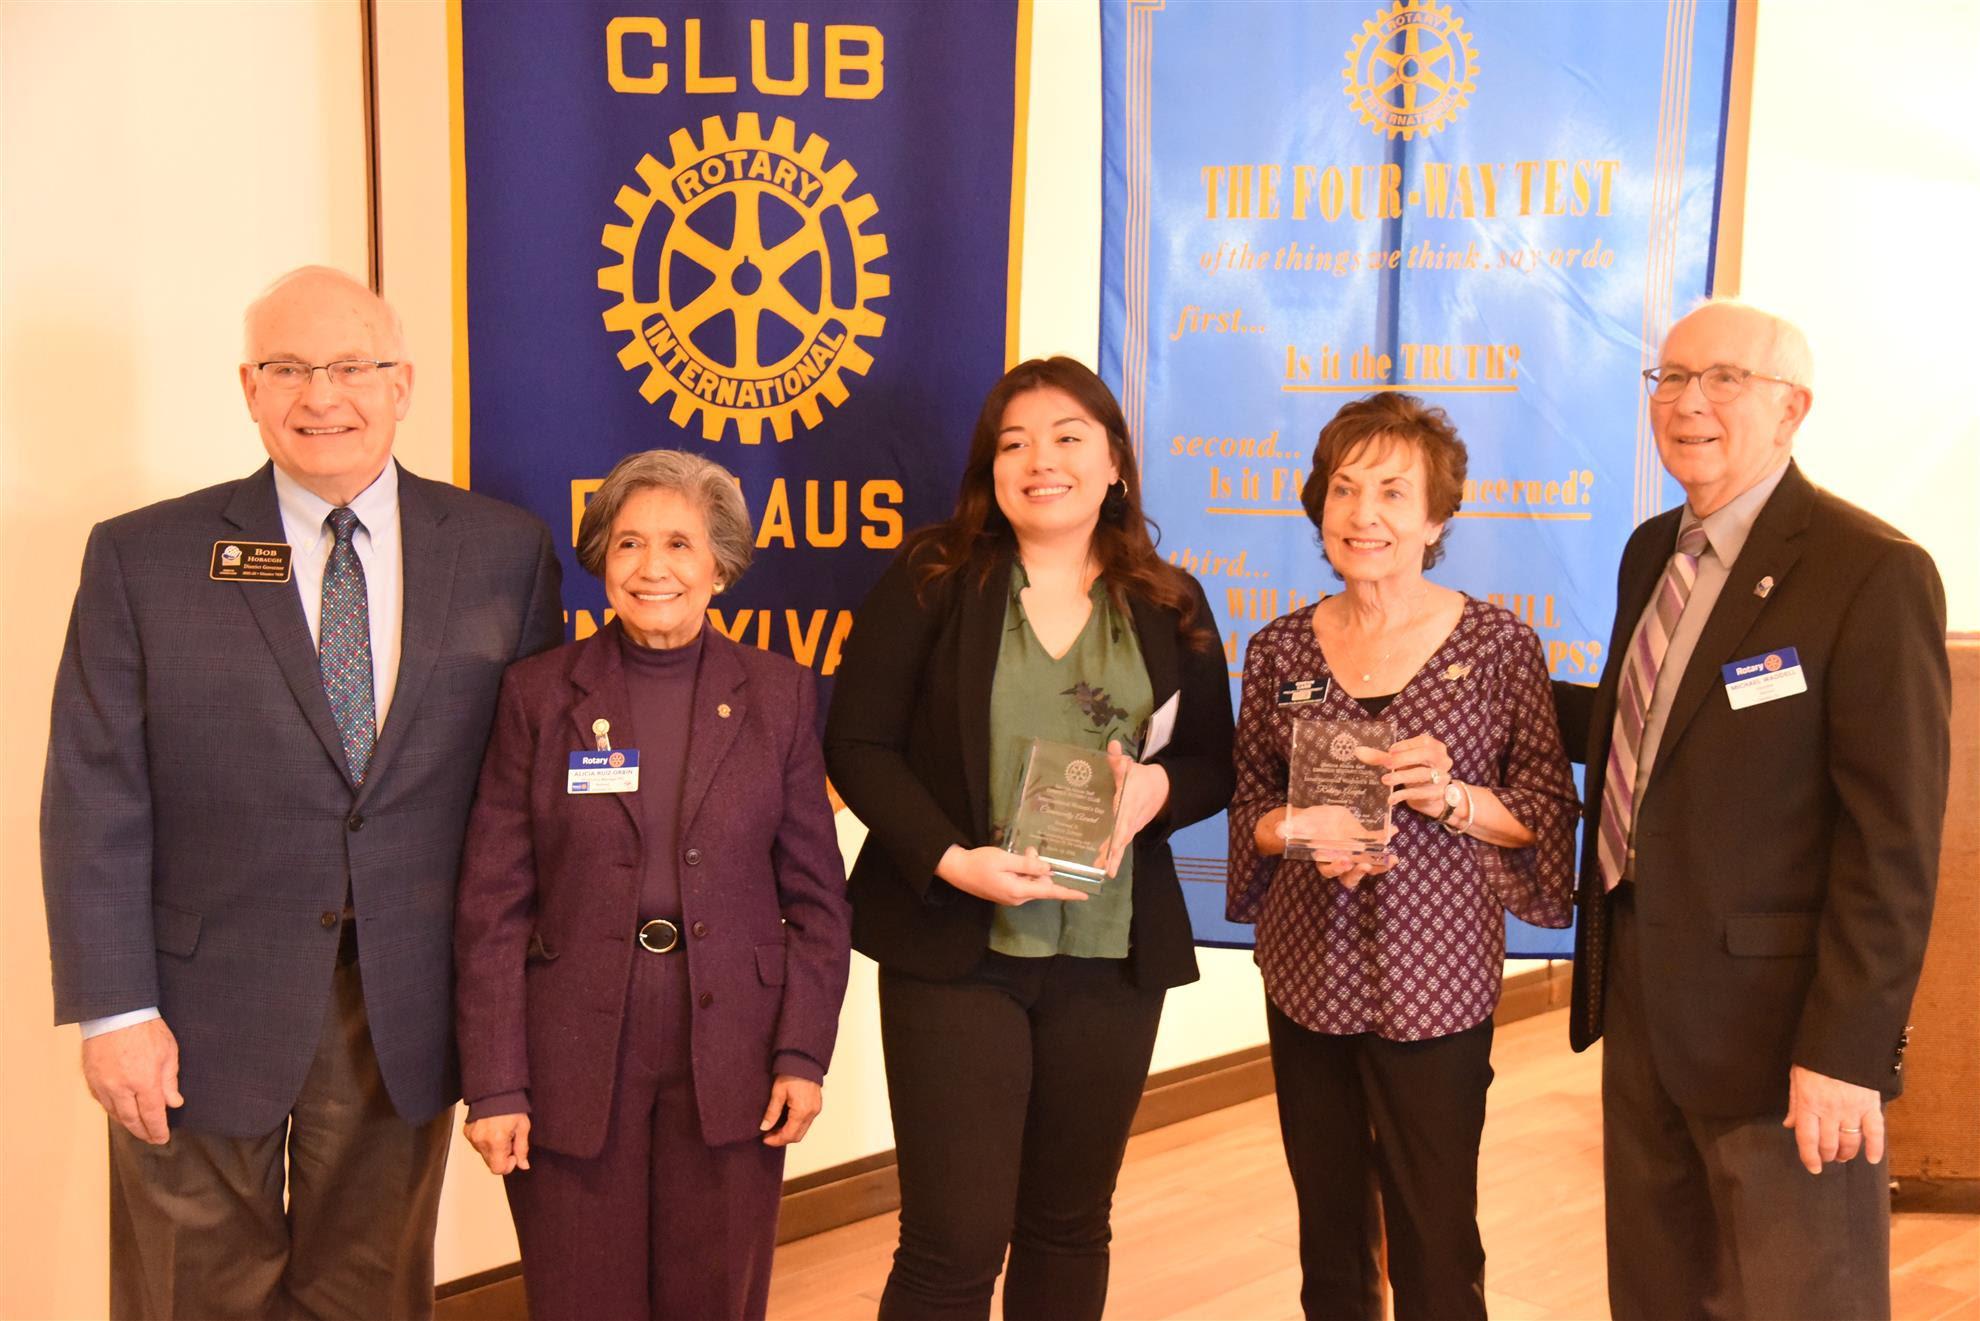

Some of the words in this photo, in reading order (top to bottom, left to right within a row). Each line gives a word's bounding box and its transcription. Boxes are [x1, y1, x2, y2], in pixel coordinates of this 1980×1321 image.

[1386, 13, 1445, 32] ROTARY
[606, 17, 884, 100] CLUB
[676, 151, 822, 202] ROTARY
[1201, 163, 1281, 221] THE
[1514, 159, 1621, 218] TEST
[1199, 241, 1229, 277] of
[1227, 242, 1271, 270] the
[1273, 241, 1362, 278] things
[1367, 249, 1402, 270] we
[1549, 248, 1582, 269] or
[1582, 238, 1615, 269] do
[1168, 304, 1266, 341] first...
[644, 319, 846, 408] INTERNATIONAL
[1285, 344, 1312, 380] Is
[1321, 343, 1341, 380] it
[1351, 343, 1392, 380] the
[1401, 343, 1521, 381] TRUTH?
[1170, 430, 1301, 459] second...
[1210, 466, 1232, 499] Is
[1241, 467, 1260, 501] it
[1462, 469, 1595, 505] ncerned?
[1168, 548, 1270, 578] third...
[1226, 587, 1278, 621] Will
[1735, 662, 1764, 676] Rotary
[582, 756, 608, 765] Rotary
